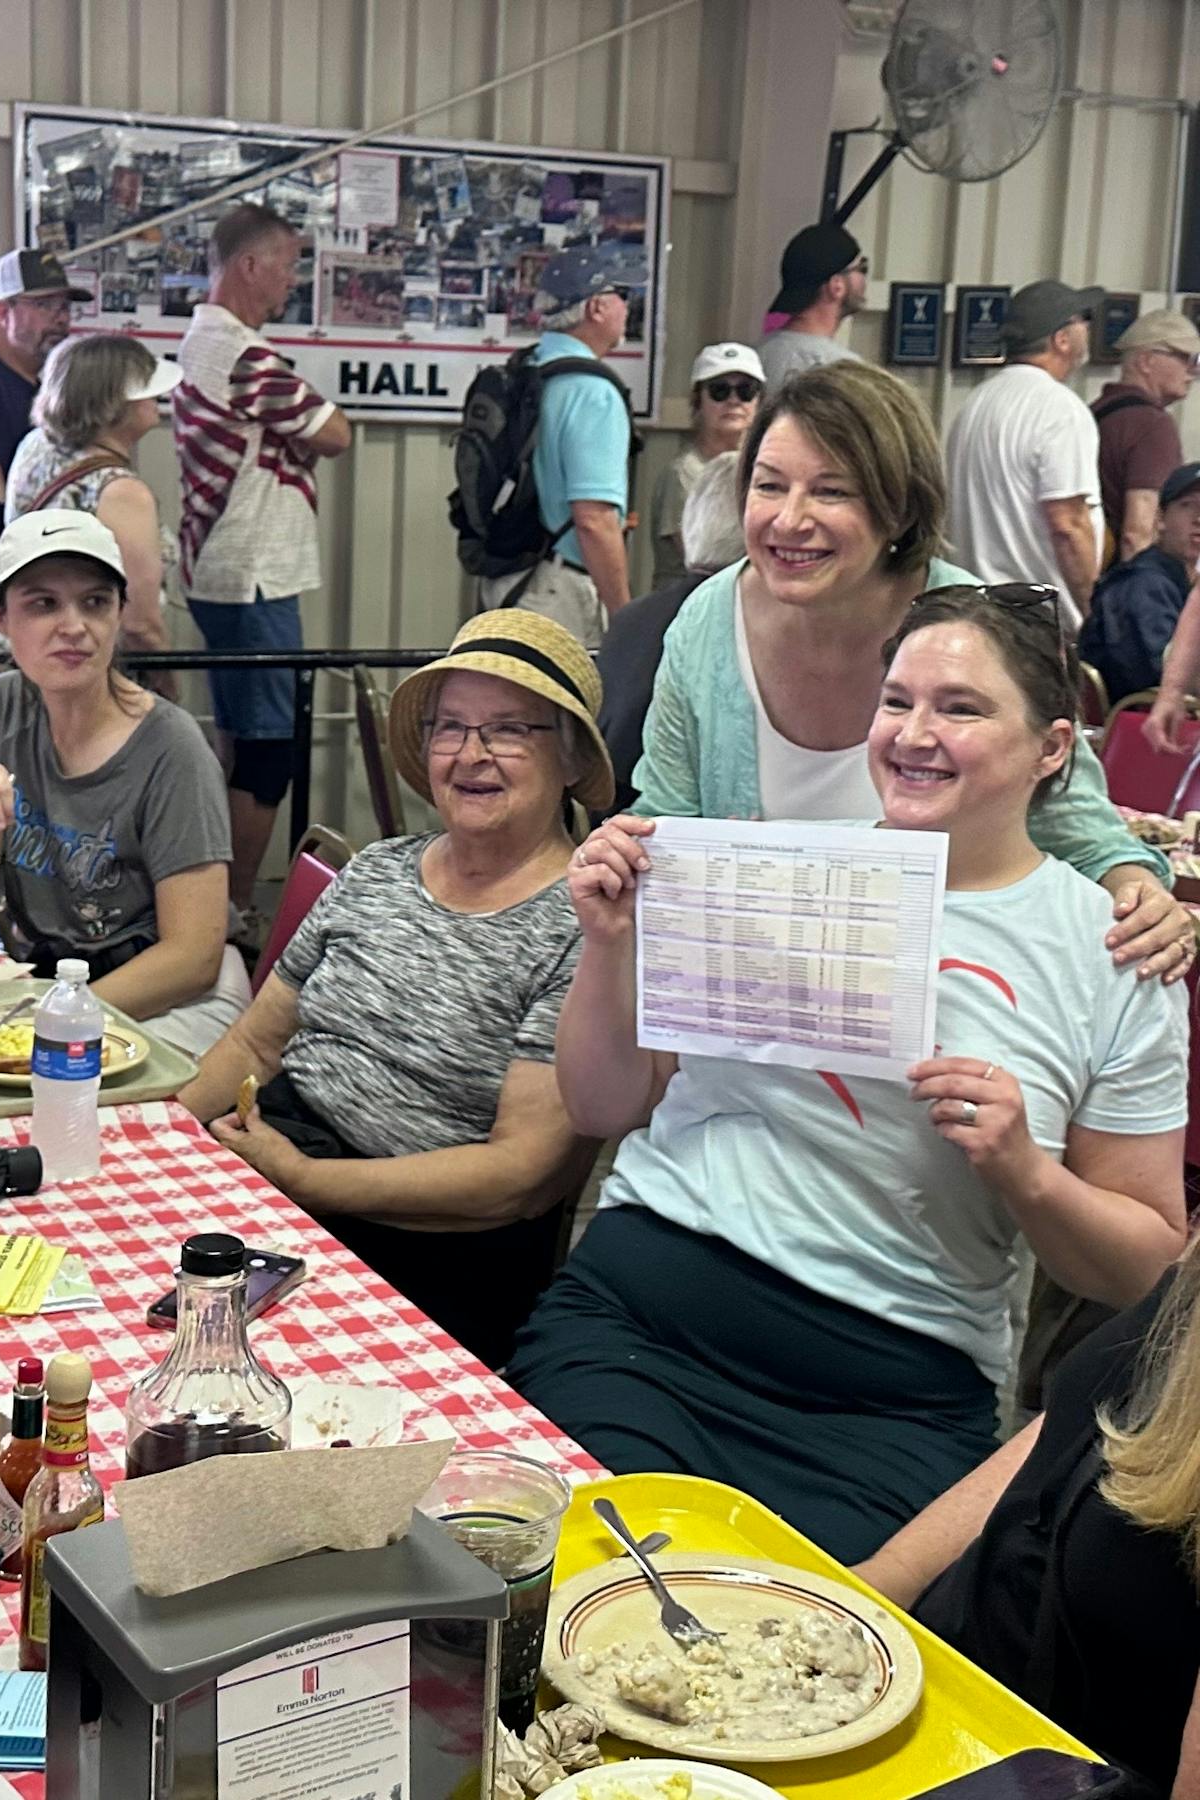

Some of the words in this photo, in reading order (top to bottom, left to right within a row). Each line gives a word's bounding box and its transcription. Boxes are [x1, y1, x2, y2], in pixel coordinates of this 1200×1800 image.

[339, 361, 448, 397] HALL
[276, 1649, 294, 1660] WILL
[295, 1646, 305, 1655] BE
[306, 1635, 341, 1651] DONATED
[276, 1696, 309, 1714] Emma
[310, 1687, 345, 1704] Norton
